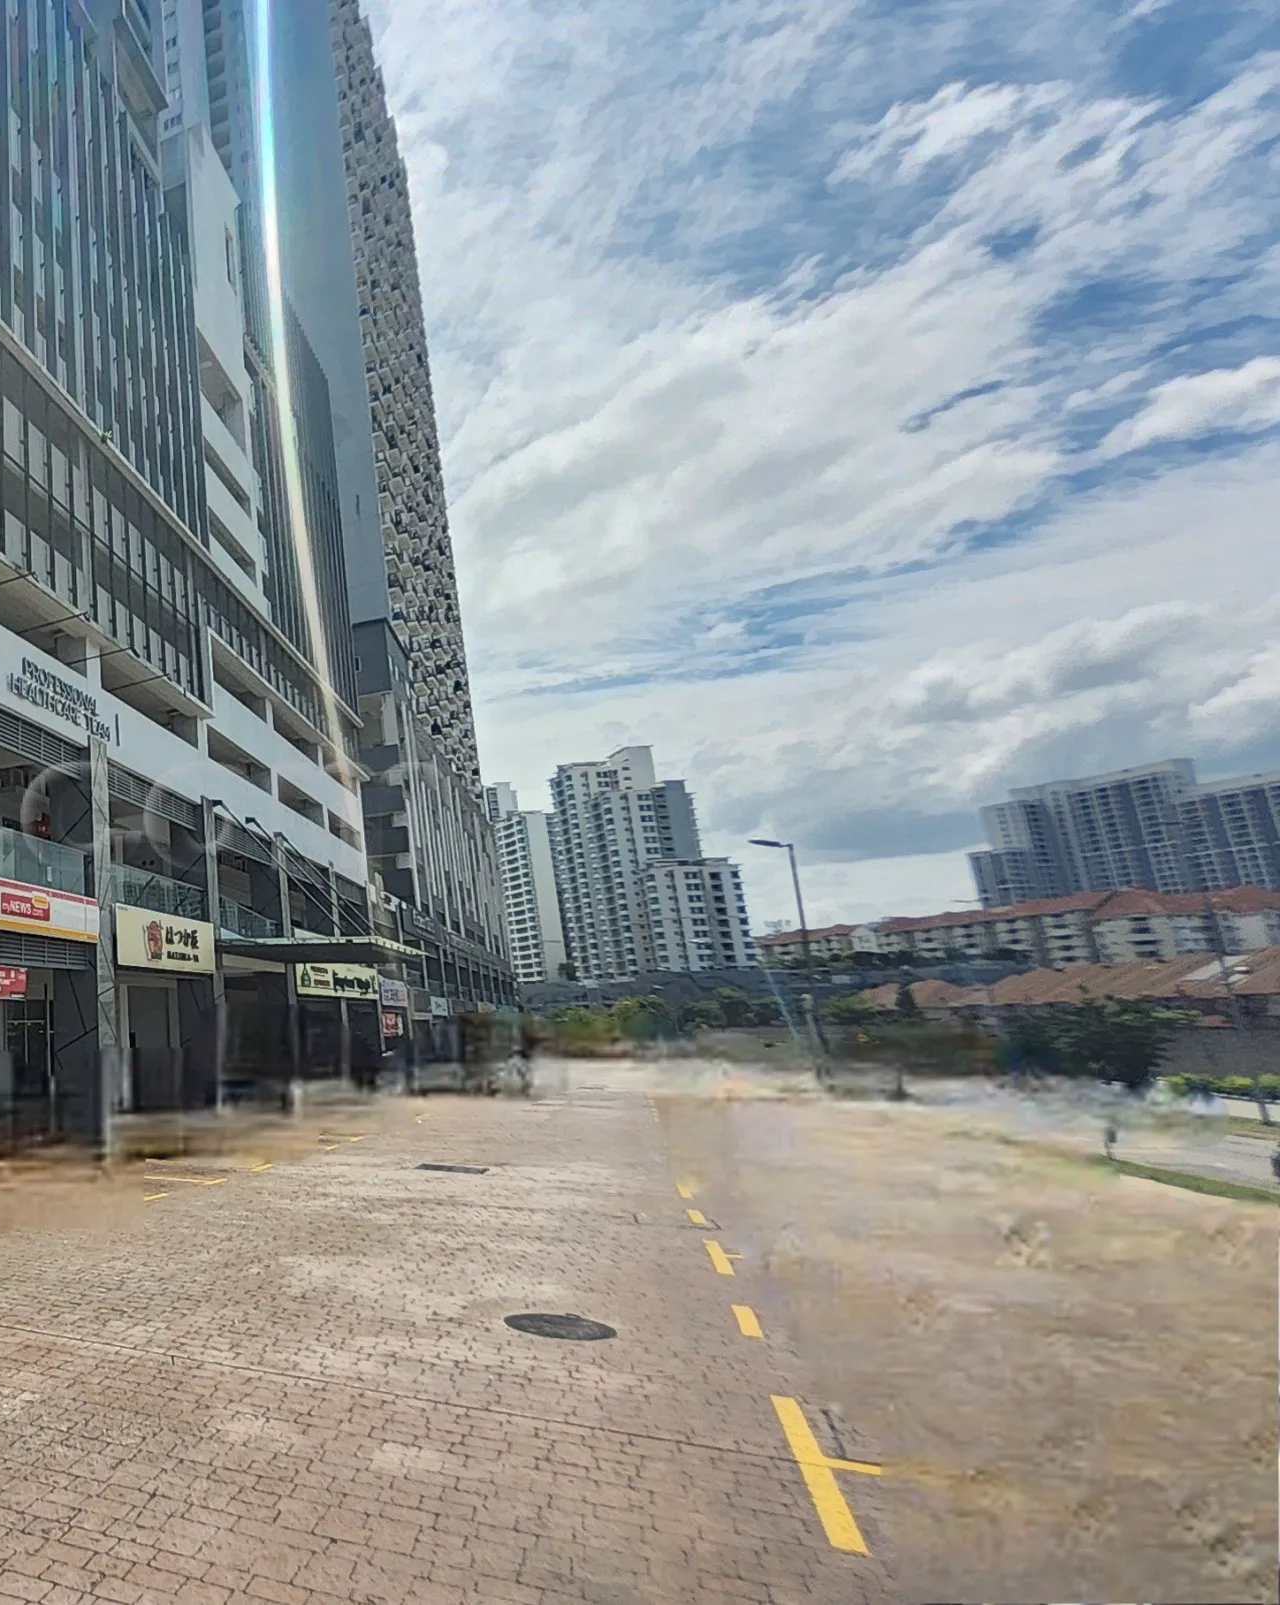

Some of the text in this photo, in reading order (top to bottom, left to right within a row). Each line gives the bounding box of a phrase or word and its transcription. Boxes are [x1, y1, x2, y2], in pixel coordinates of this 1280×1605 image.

[7, 672, 110, 742] HEALTHCARE TEAM
[22, 656, 100, 717] PROFESSIONAL
